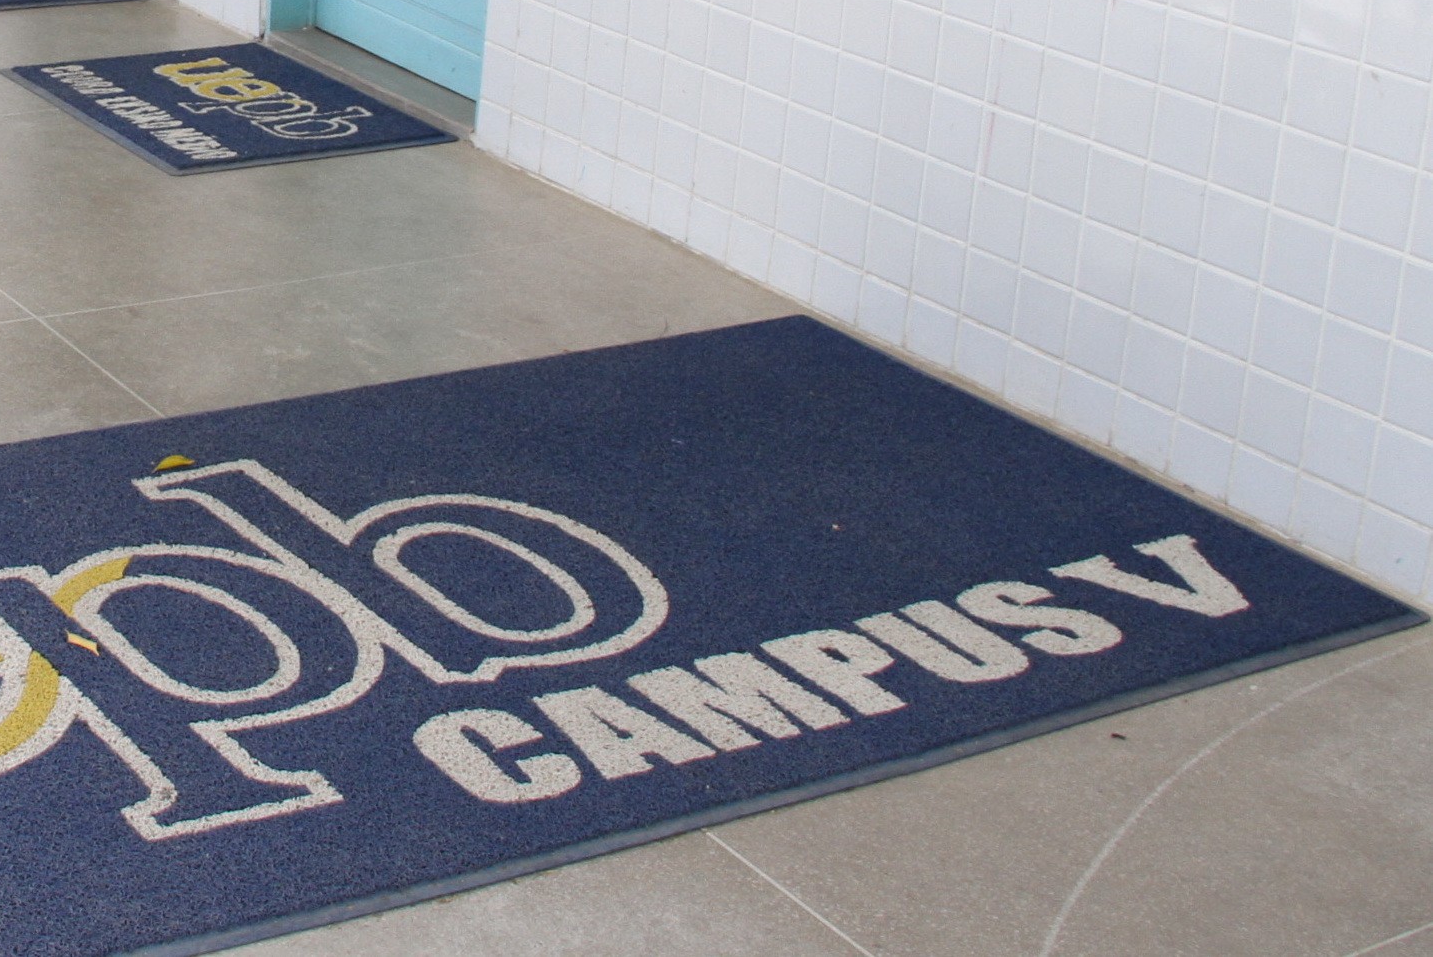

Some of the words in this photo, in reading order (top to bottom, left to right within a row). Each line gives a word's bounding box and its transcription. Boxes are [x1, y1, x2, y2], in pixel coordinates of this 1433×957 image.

[153, 57, 373, 140] uepb
[412, 580, 1124, 804] CAMPUS
[1048, 534, 1250, 618] V
